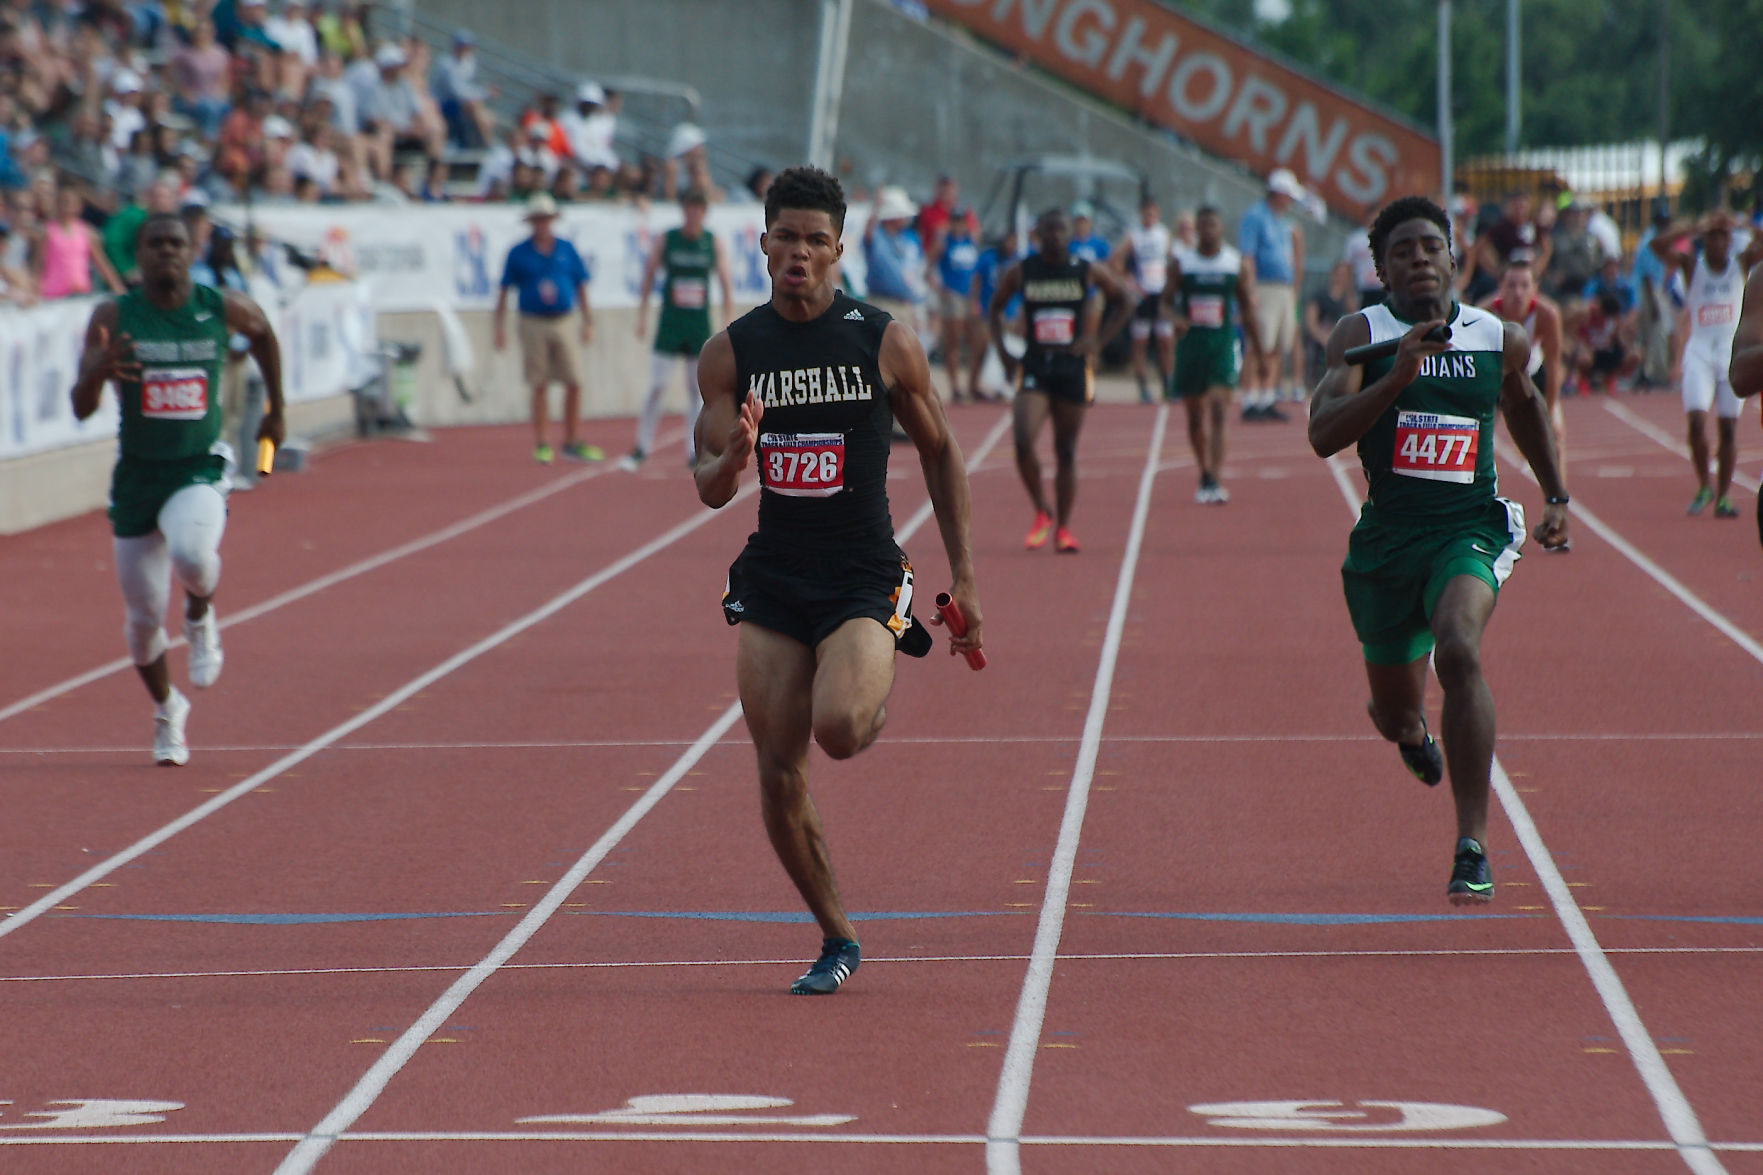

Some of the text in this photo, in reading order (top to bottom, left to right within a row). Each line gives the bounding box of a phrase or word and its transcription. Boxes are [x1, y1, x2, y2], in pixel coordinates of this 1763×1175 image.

[950, 0, 1398, 201] NGHORNS
[1420, 354, 1476, 378] DIANS
[749, 366, 872, 408] MARSHALL
[1418, 415, 1439, 423] STATE
[779, 433, 798, 442] STATE
[1400, 433, 1473, 466] 4477
[768, 451, 838, 483] 3726
